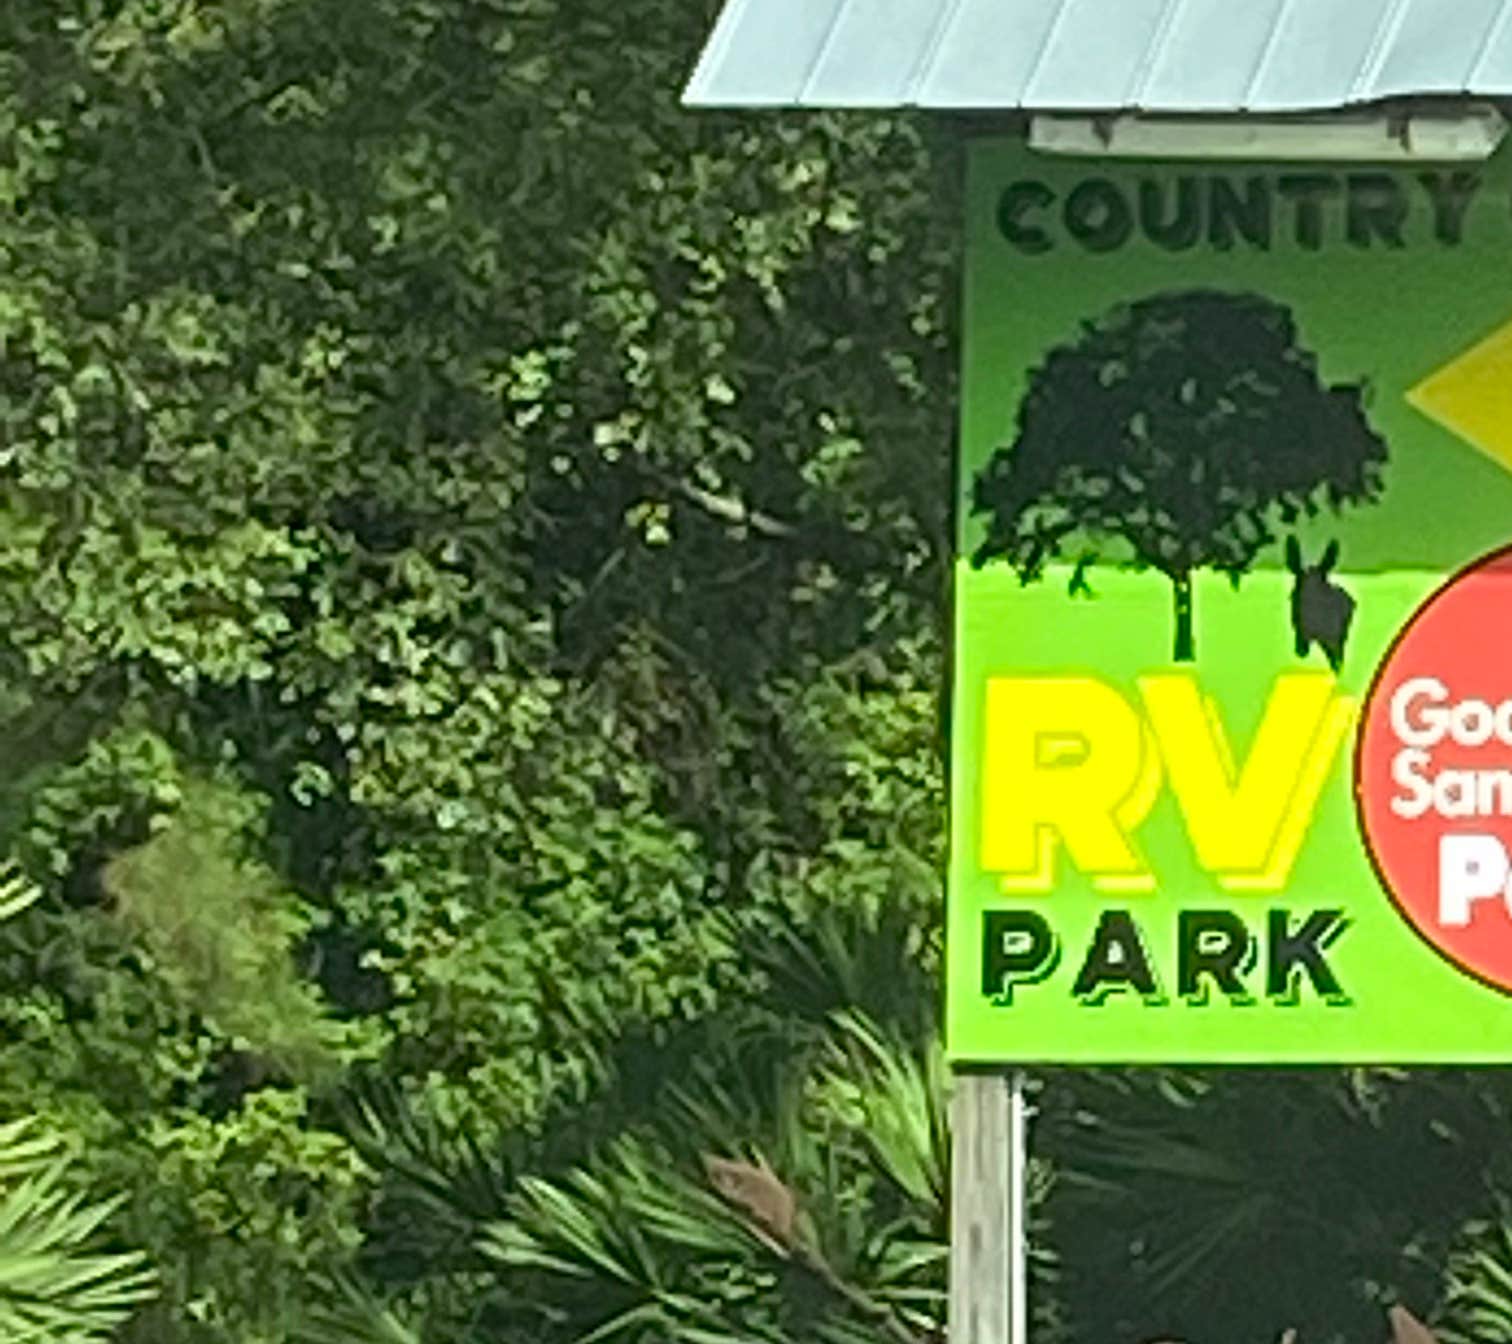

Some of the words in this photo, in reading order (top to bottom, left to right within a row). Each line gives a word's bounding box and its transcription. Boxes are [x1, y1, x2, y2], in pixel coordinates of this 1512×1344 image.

[998, 166, 1481, 253] COUNTRY
[981, 669, 1358, 895] RV
[980, 909, 1355, 1008] PARK
